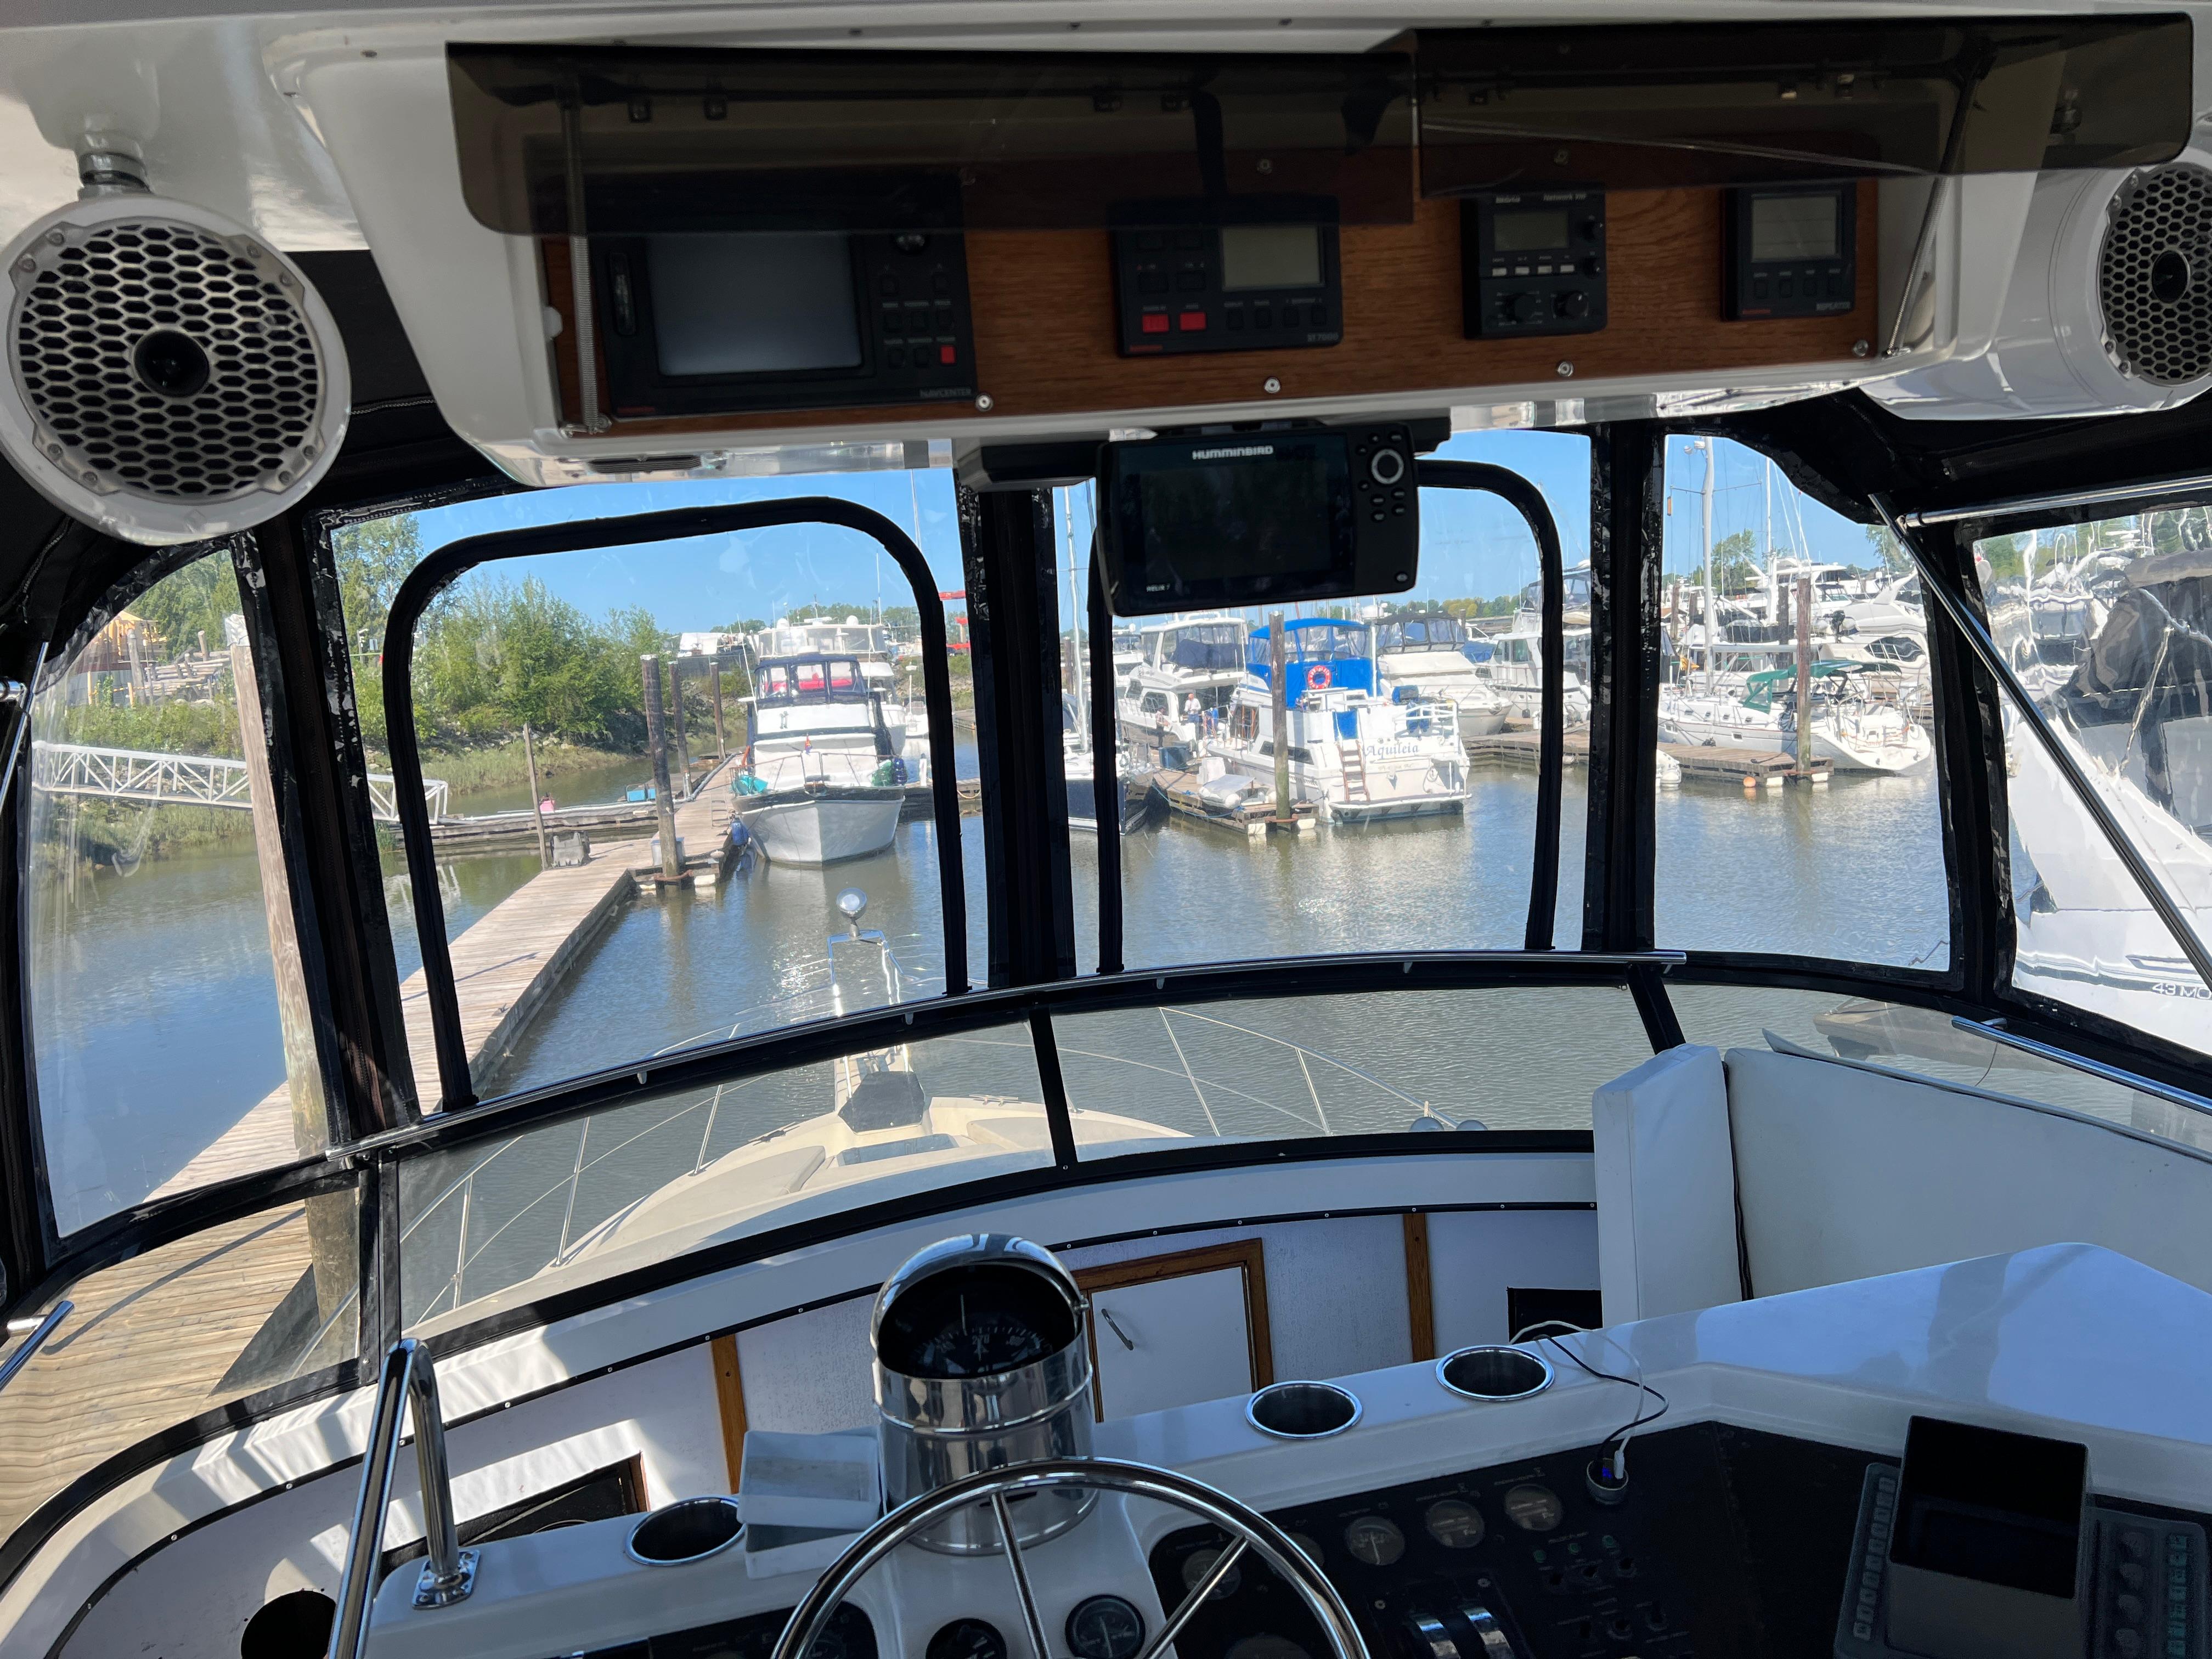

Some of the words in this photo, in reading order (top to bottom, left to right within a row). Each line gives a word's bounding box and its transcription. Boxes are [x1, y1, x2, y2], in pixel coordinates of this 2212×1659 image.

[1192, 445, 1273, 460] HUMMINBIRD
[1364, 742, 1420, 759] Aquileia
[2152, 983, 2176, 996] 43
